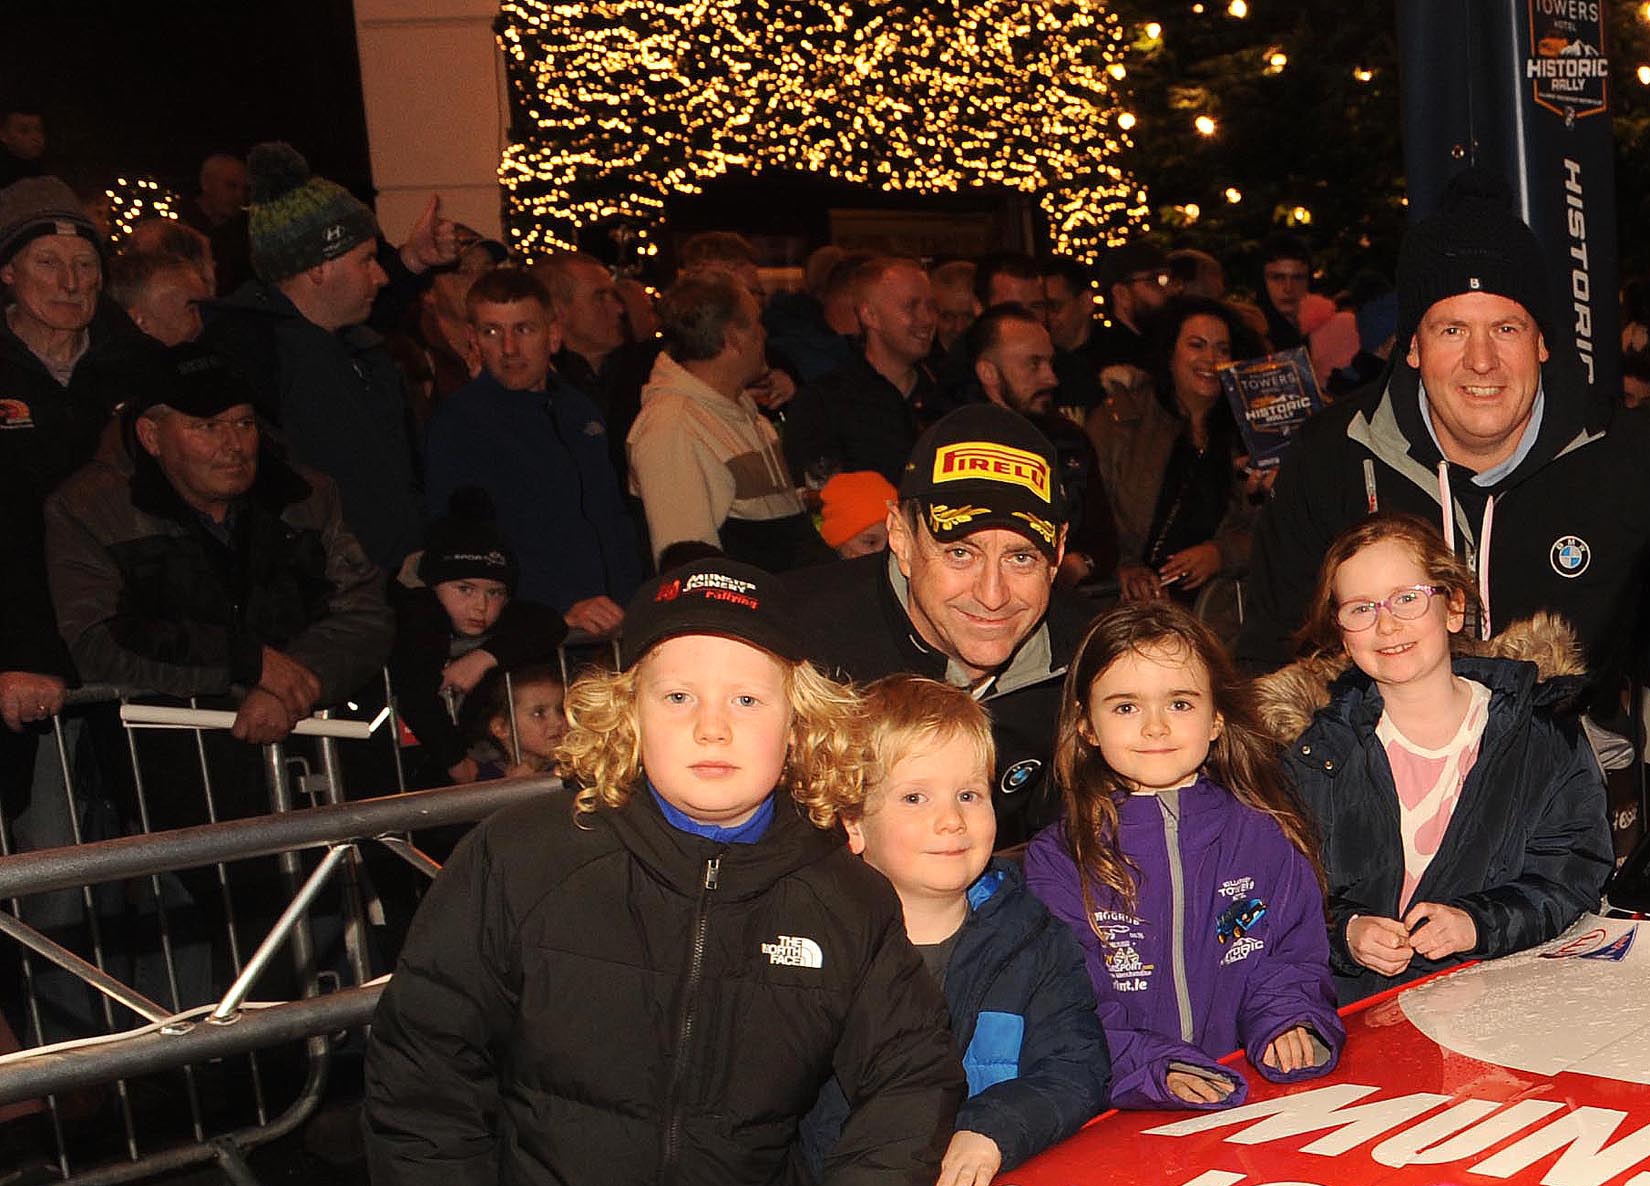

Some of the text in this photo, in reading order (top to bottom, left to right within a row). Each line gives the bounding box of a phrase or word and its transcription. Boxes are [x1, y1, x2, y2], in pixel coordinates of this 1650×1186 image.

[1535, 0, 1599, 22] TOWERS
[1527, 59, 1608, 78] HISTORIC
[1551, 79, 1586, 91] RALLY
[1242, 372, 1297, 390] TOWERS
[1245, 396, 1312, 421] HISTORIC
[943, 448, 1046, 490] PIRELLI
[682, 576, 746, 593] JOINERY
[761, 942, 801, 956] NORTH
[778, 935, 802, 946] THE
[770, 954, 801, 966] FACE
